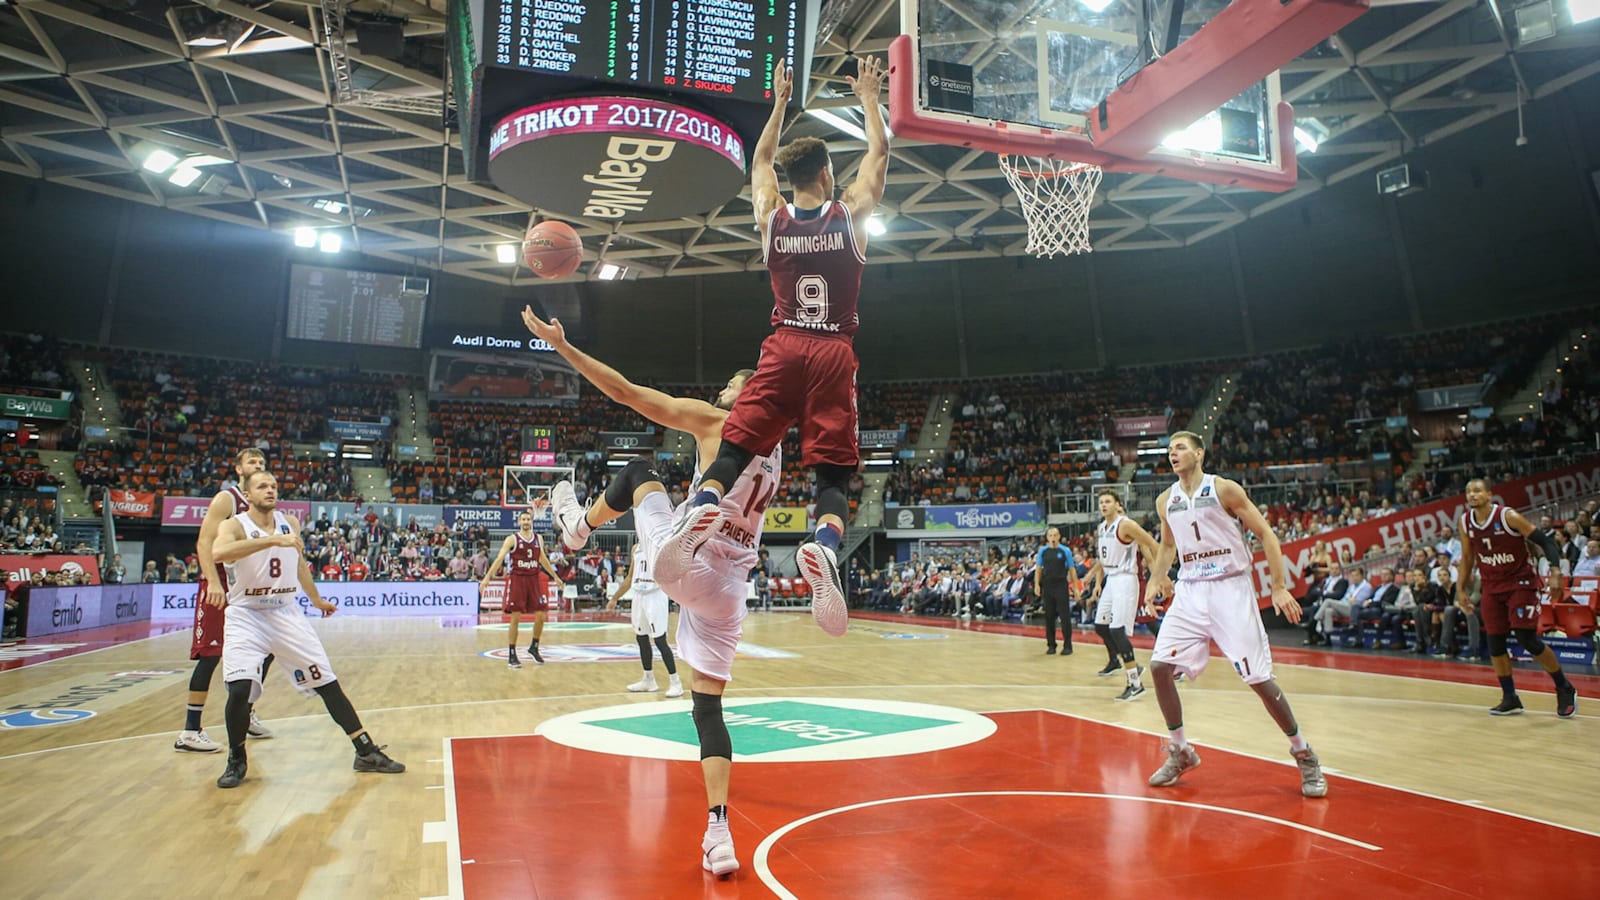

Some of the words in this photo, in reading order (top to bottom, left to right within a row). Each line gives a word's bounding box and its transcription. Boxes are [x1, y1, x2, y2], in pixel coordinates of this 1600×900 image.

[500, 5, 512, 14] 15
[521, 7, 532, 17] R.
[534, 9, 582, 24] REDDING
[632, 23, 640, 32] 2
[534, 0, 587, 15] DJEDOVIC
[628, 13, 640, 23] 15
[672, 10, 679, 19] 7
[686, 12, 697, 22] D.
[699, 15, 755, 31] LAVRINOVIC
[697, 5, 755, 21] AUKSTIKALN
[768, 7, 775, 16] 2
[520, 17, 531, 27] S.
[533, 20, 564, 31] JOVIC
[609, 30, 617, 39] 2
[686, 22, 697, 31] G.
[699, 24, 755, 40] LEONAVICIU
[498, 24, 511, 34] 22
[520, 27, 531, 37] D.
[533, 29, 581, 44] BARTHEL
[609, 40, 617, 49] 2
[626, 42, 639, 52] 10
[498, 34, 511, 44] 25
[519, 37, 530, 47] A.
[532, 39, 567, 52] GAVEL
[608, 49, 616, 59] 2
[666, 29, 678, 38] 11
[686, 31, 696, 41] G.
[699, 33, 735, 46] TALTON
[497, 44, 510, 53] 31
[520, 47, 530, 57] D.
[532, 48, 577, 63] BOOKER
[665, 48, 677, 57] 13
[685, 50, 695, 60] S.
[696, 52, 737, 66] JASAITIS
[666, 39, 678, 48] 12
[697, 43, 753, 59] LAVRINOVIC
[497, 54, 510, 63] 33
[519, 57, 531, 67] M.
[532, 58, 570, 72] ZIRBES
[665, 57, 677, 66] 14
[684, 60, 694, 69] V.
[695, 61, 751, 78] CEPUKAITIS
[664, 67, 676, 76] 31
[695, 71, 736, 85] PEINERS
[694, 80, 734, 93] SKUCAS
[513, 104, 599, 138] TRIKOT
[607, 103, 722, 147] 2017/2018
[582, 135, 677, 218] BayWa
[774, 232, 845, 254] CUNNINGHAM
[795, 274, 829, 324] 9
[452, 334, 484, 346] Audi
[486, 336, 522, 349] Dome
[6, 398, 53, 413] BayWa
[537, 438, 550, 450] 13
[455, 510, 501, 520] HIRMER
[955, 508, 1012, 528] TRENTINO
[1191, 520, 1202, 542] 1
[1101, 545, 1108, 558] 6
[1482, 538, 1492, 550] 7
[526, 549, 533, 558] 3
[269, 557, 282, 579] 8
[244, 586, 271, 597] LIET
[344, 595, 377, 607] aus
[380, 591, 470, 607] München.
[52, 593, 83, 628] emilo
[115, 591, 138, 619] emilo
[1525, 605, 1535, 619] 7
[308, 664, 322, 681] 8
[1242, 657, 1251, 677] 1
